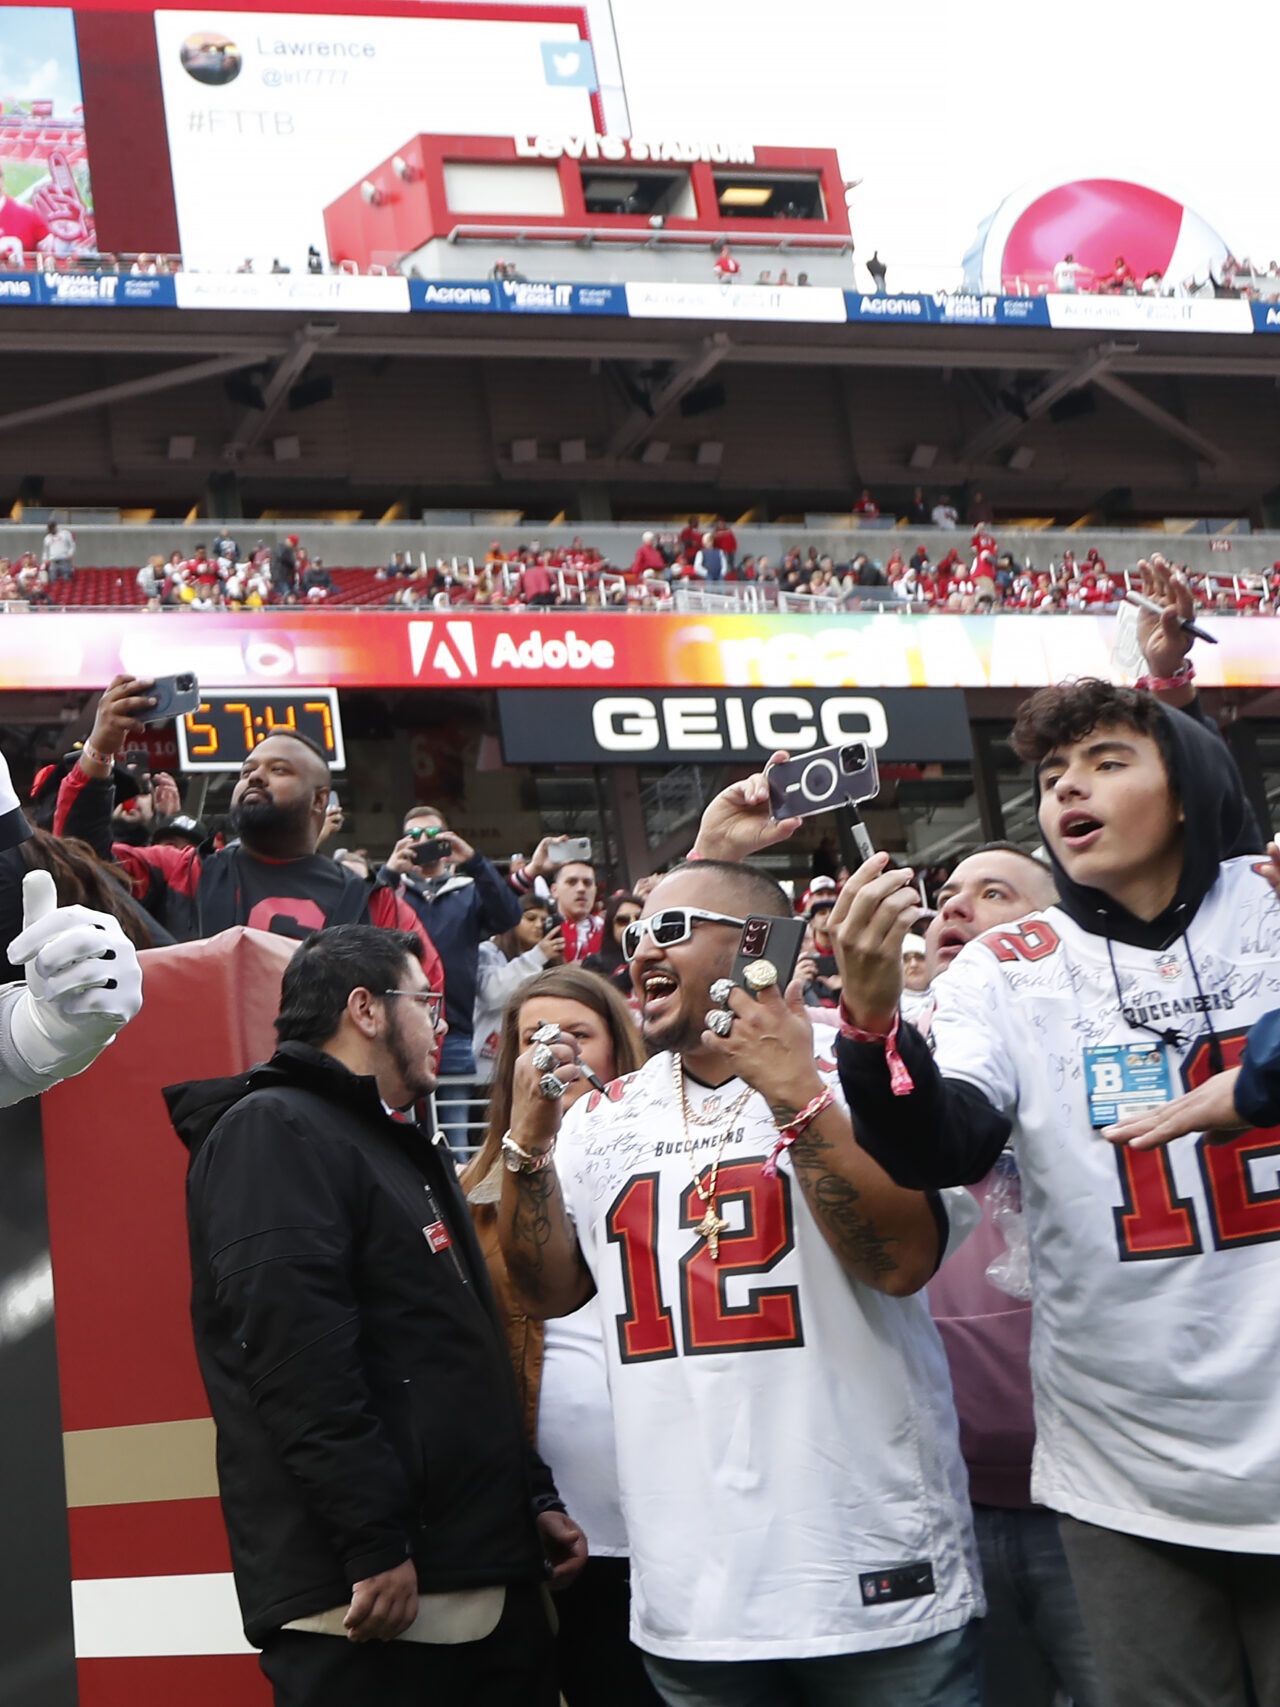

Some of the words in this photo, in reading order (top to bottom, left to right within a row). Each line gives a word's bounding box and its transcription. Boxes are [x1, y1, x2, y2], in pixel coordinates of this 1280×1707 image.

[256, 36, 377, 58] Lawrence
[187, 109, 296, 136] #FTTB
[425, 285, 491, 304] Acronis
[860, 297, 921, 316] Acronis
[491, 630, 615, 670] Adobe
[185, 702, 335, 755] 57:47
[593, 695, 889, 751] GEICO
[1090, 1062, 1123, 1094] B
[607, 1155, 804, 1364] 12
